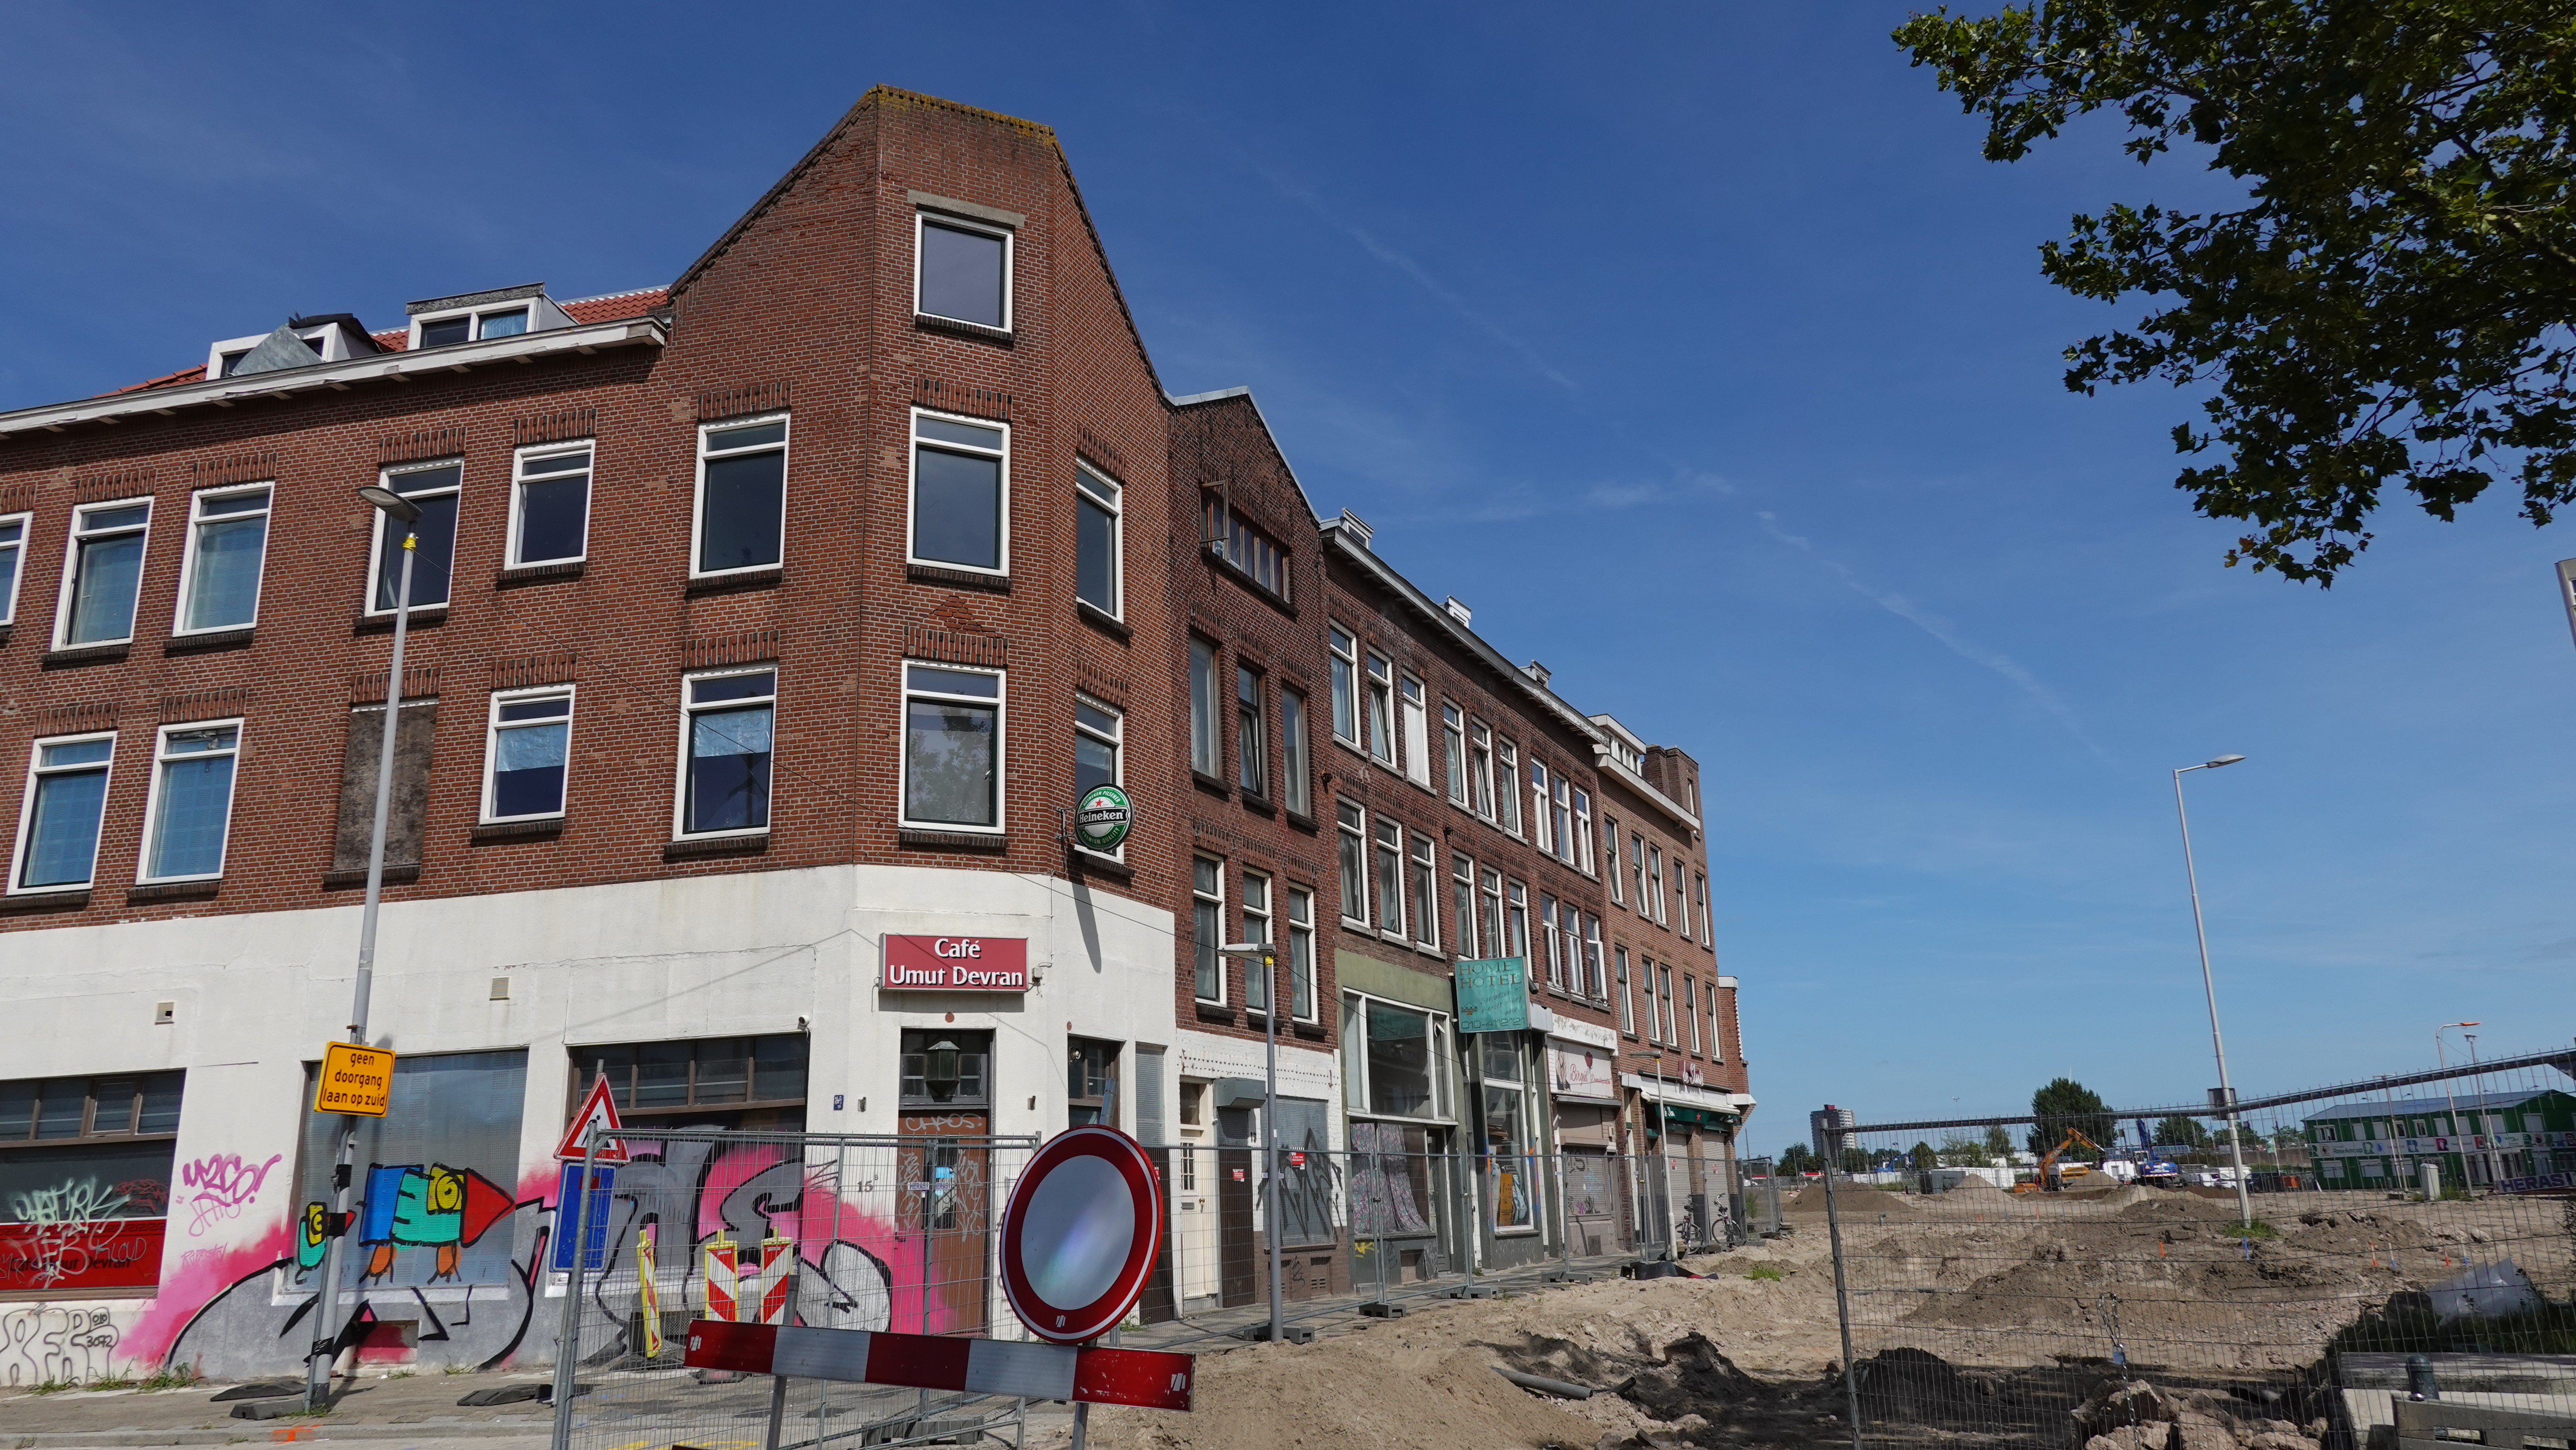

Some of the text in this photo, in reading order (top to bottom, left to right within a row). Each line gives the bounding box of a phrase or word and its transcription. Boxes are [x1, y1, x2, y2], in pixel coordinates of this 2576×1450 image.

[1083, 790, 1121, 806] HEINEKEN PILSENER
[1079, 811, 1124, 824] Heineken
[1082, 827, 1120, 844] PREMIUM QUALITY
[934, 938, 981, 959] Café
[890, 965, 1023, 986] Umut Devran
[1459, 961, 1513, 975] HOME
[1459, 973, 1522, 989] HOTEL
[1461, 1017, 1525, 1030] 010-4112121
[350, 1053, 374, 1067] geen
[335, 1069, 382, 1091] doorgang
[1570, 1063, 1589, 1086] Birgül
[322, 1088, 386, 1107] laan op zuid
[1250, 1131, 1256, 1144] 13
[857, 1180, 873, 1192] 15
[2501, 1173, 2565, 1192] HERAS
